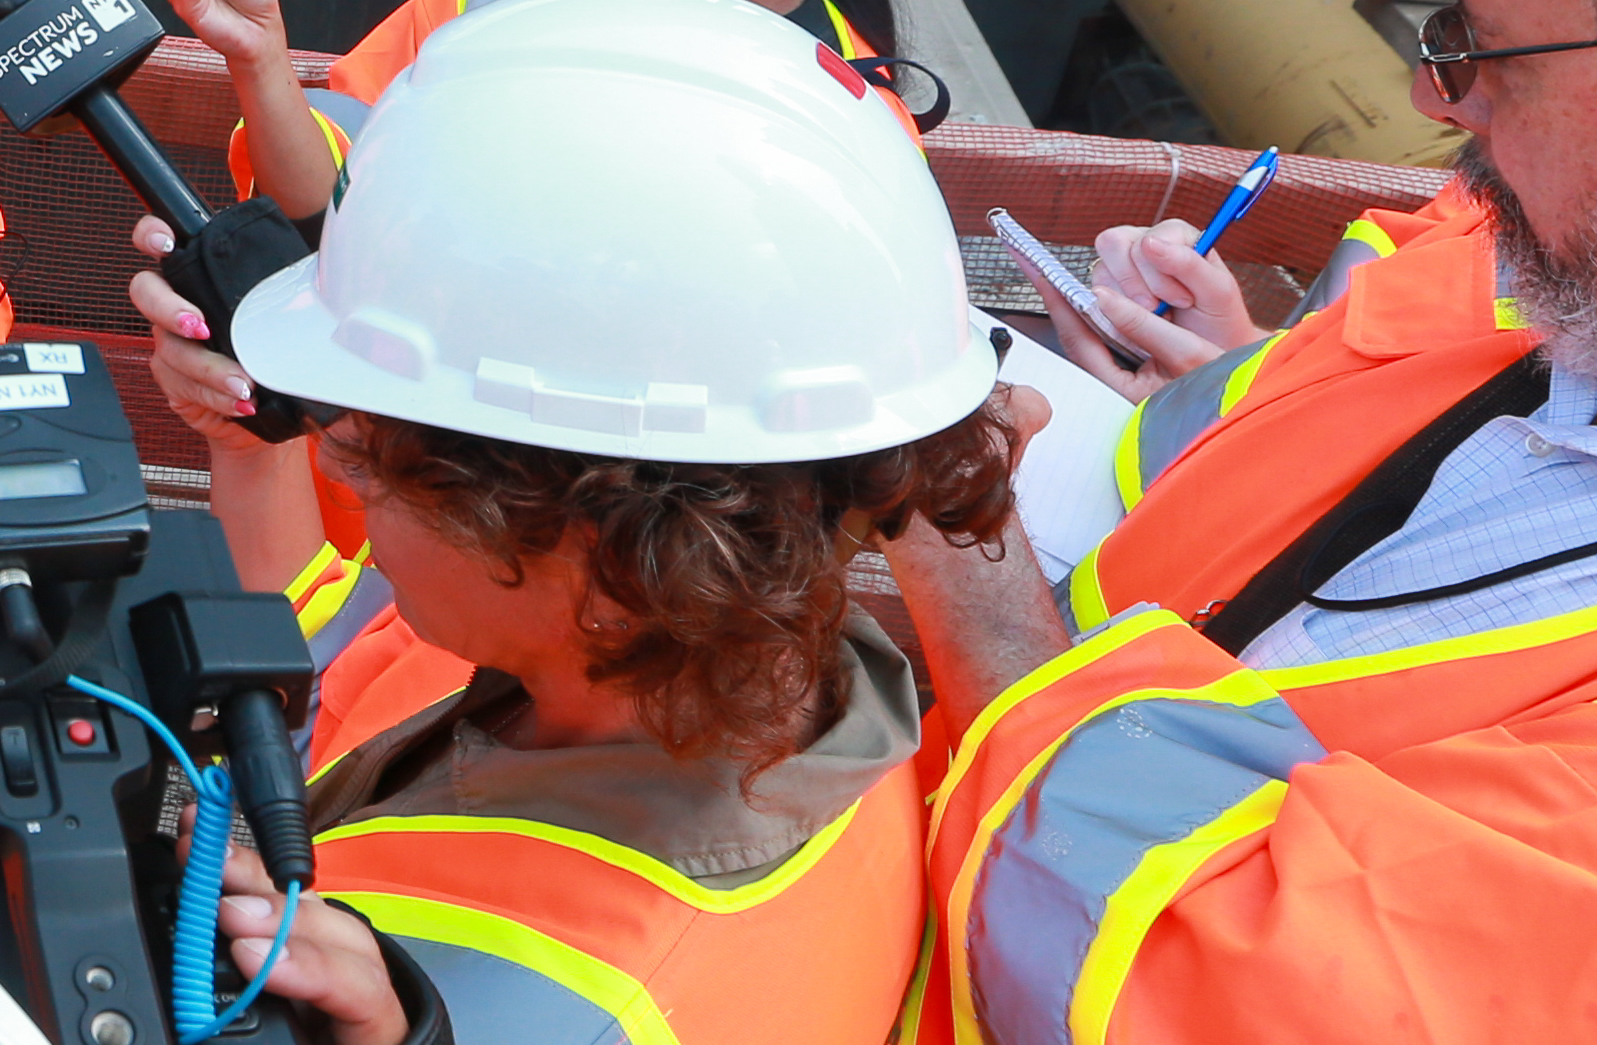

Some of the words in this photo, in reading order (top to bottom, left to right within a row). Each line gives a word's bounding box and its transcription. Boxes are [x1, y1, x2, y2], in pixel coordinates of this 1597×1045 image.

[113, 1, 129, 14] 1
[17, 20, 99, 86] NEWS
[38, 351, 68, 365] RX
[12, 384, 57, 398] NY1
